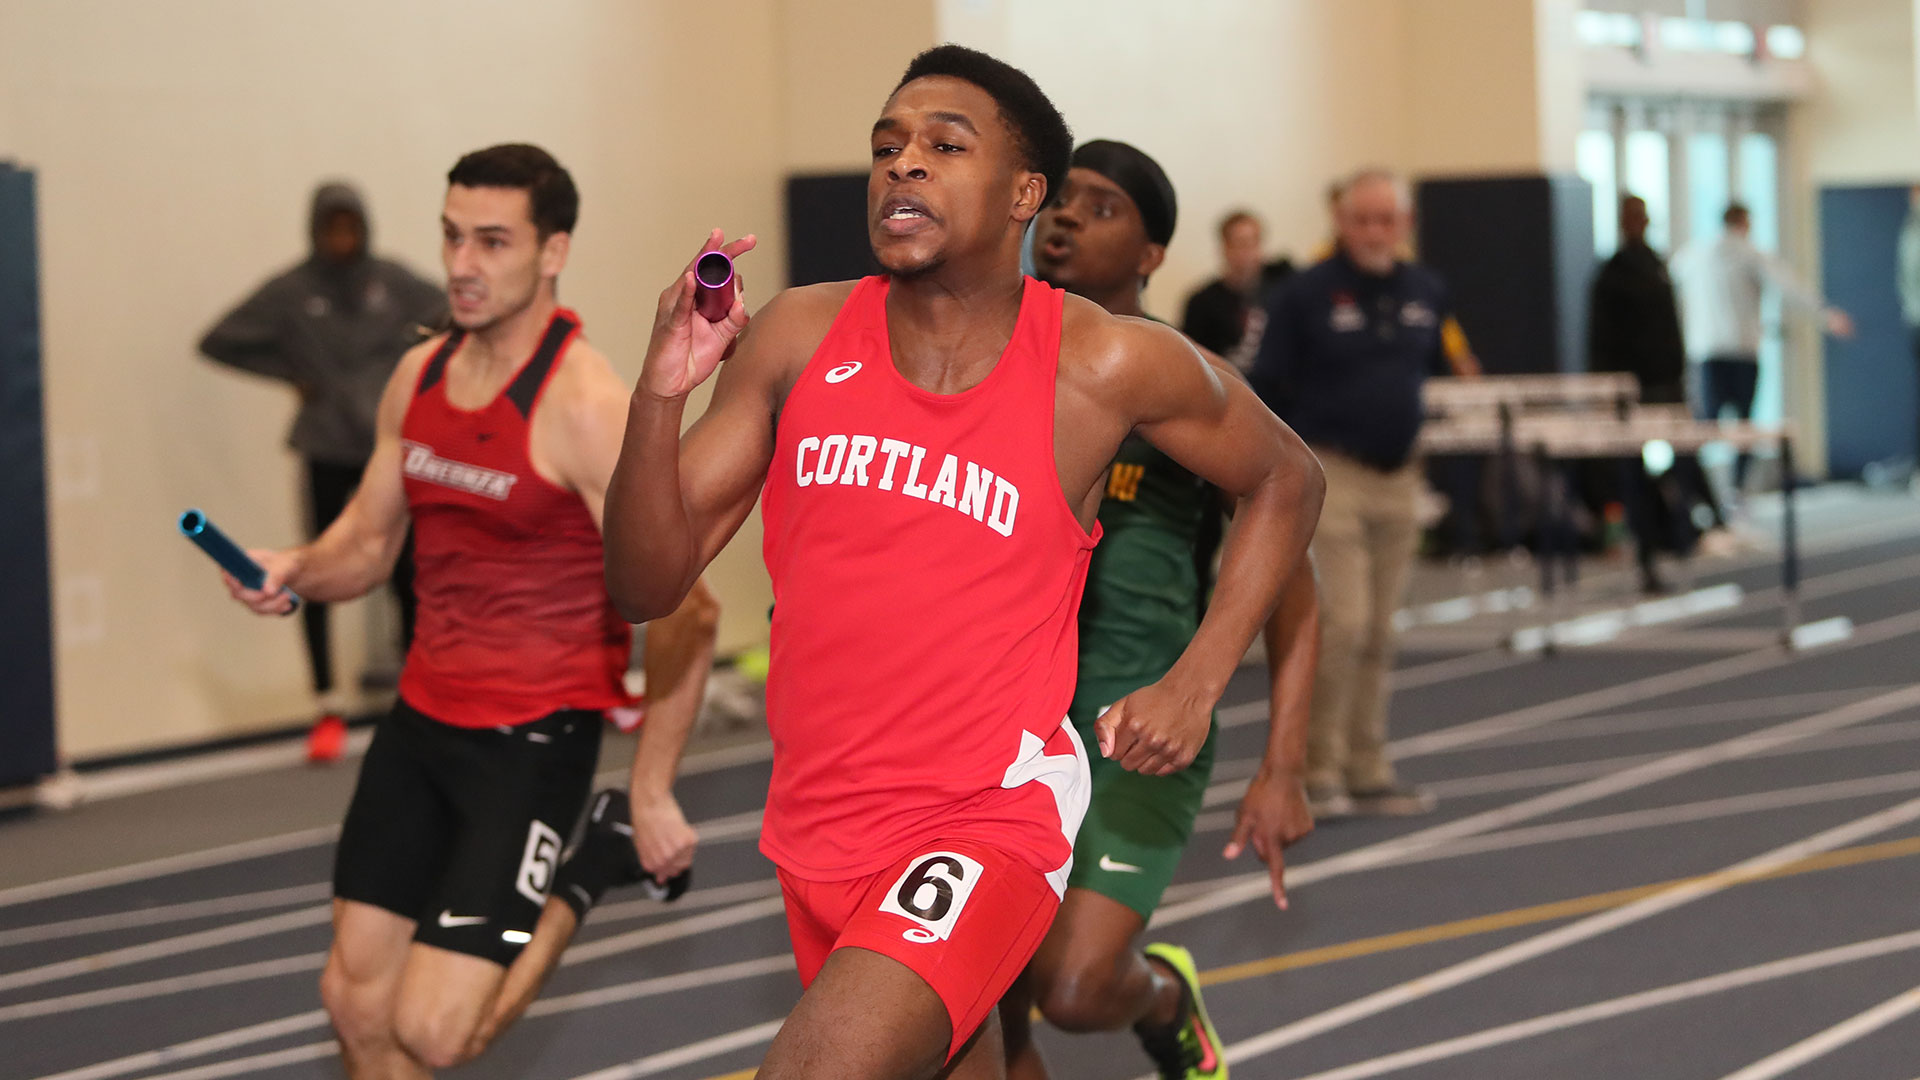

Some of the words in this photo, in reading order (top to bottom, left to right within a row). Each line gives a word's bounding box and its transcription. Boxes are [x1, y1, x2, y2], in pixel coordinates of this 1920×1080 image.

[796, 434, 1020, 538] CORTLAND
[527, 833, 556, 895] 5
[897, 856, 965, 922] 6
